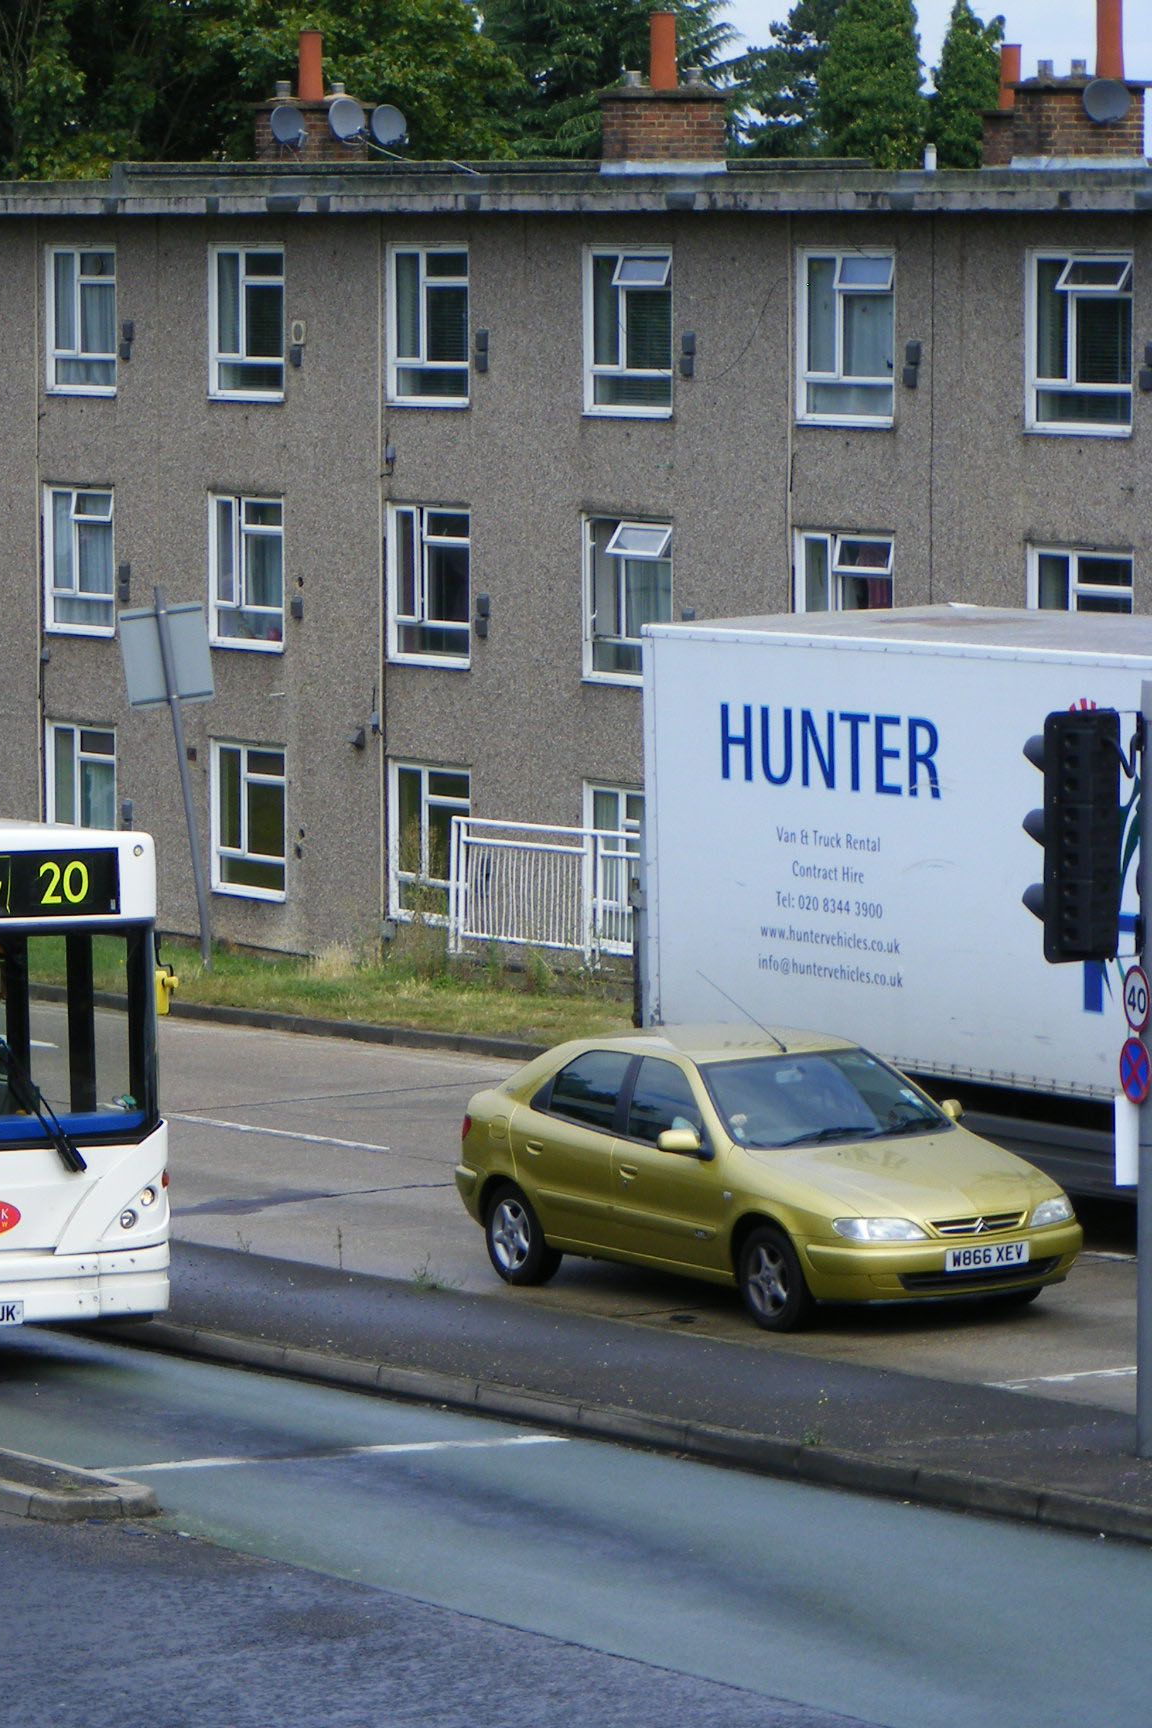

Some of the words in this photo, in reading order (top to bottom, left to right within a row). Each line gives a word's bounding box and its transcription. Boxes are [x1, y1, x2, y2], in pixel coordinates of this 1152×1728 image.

[720, 702, 941, 799] HUNTER
[776, 826, 796, 843] Van
[800, 829, 808, 845] &
[812, 830, 841, 849] Truck
[846, 834, 881, 852] Rental
[38, 860, 89, 905] 20
[792, 861, 838, 882] Contract
[842, 867, 864, 884] Hire
[776, 891, 794, 909] Tel:
[798, 895, 818, 911] 020
[823, 898, 850, 914] 8344
[855, 901, 883, 919] 3900
[760, 925, 900, 955] www.huntervehicles.co.uk
[758, 954, 903, 988] info@huntervehicles.co.uk
[1127, 985, 1147, 1014] 40
[952, 1248, 992, 1267] W866
[996, 1243, 1023, 1262] XEV
